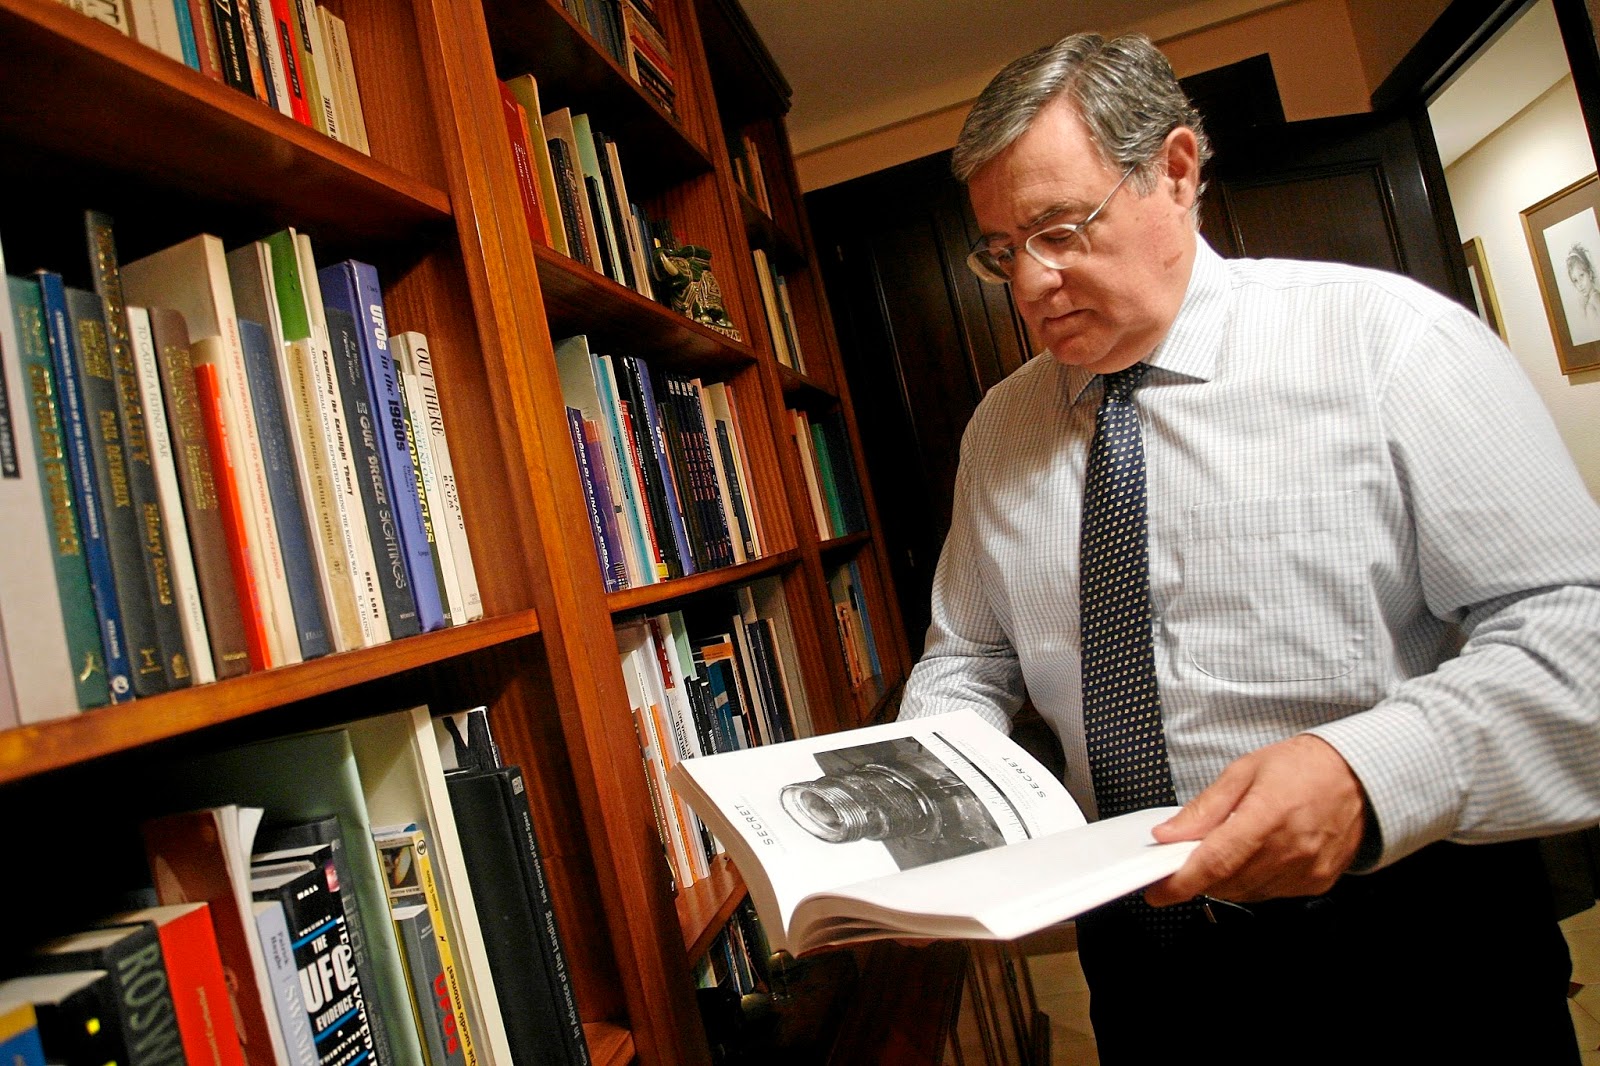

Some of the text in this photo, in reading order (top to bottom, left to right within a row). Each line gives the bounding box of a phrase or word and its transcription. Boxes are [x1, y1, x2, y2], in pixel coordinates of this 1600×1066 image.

[139, 341, 155, 378] CATCH
[368, 303, 408, 452] UFOs in the 1980s
[147, 380, 156, 389] A
[414, 345, 446, 438] OUT THERE
[148, 392, 164, 429] FLYING
[319, 349, 354, 496] Examining the Earthlight Theory
[410, 409, 423, 449] ITALIA
[155, 430, 169, 457] STAR
[418, 451, 426, 464] IN
[572, 419, 588, 464] Belgique
[236, 372, 253, 438] INTERNATIONAL
[253, 462, 268, 514] SYMPOSIUM
[264, 517, 281, 579] PROCEEDINGS
[308, 345, 358, 576] ADVANCED AERIAL DEVICES REPORTED DURING THE KOREAN WAR
[583, 467, 589, 477] la
[404, 417, 420, 467] CROP
[413, 469, 433, 543] CIRCLES
[442, 474, 454, 509] BLUM
[358, 414, 407, 589] GULF BREEZE SIGHTINGS
[447, 474, 464, 530] HOWARD
[589, 496, 602, 533] d'OVNI
[598, 535, 611, 569] Vague
[360, 610, 371, 638] HAINES
[1002, 756, 1046, 798] SECRET
[520, 810, 531, 831] Space
[734, 804, 774, 846] SECRET
[525, 831, 534, 850] Outer
[531, 858, 545, 888] Concepts
[275, 931, 291, 965] Patrick
[311, 934, 328, 954] THE
[298, 944, 352, 1013] UFO
[445, 964, 461, 1010] entonces?
[542, 910, 581, 1038] In Advance of the Landing
[280, 984, 317, 1066] SWAM
[315, 995, 355, 1032] EVIDENCE
[457, 1012, 471, 1047] sucedió
